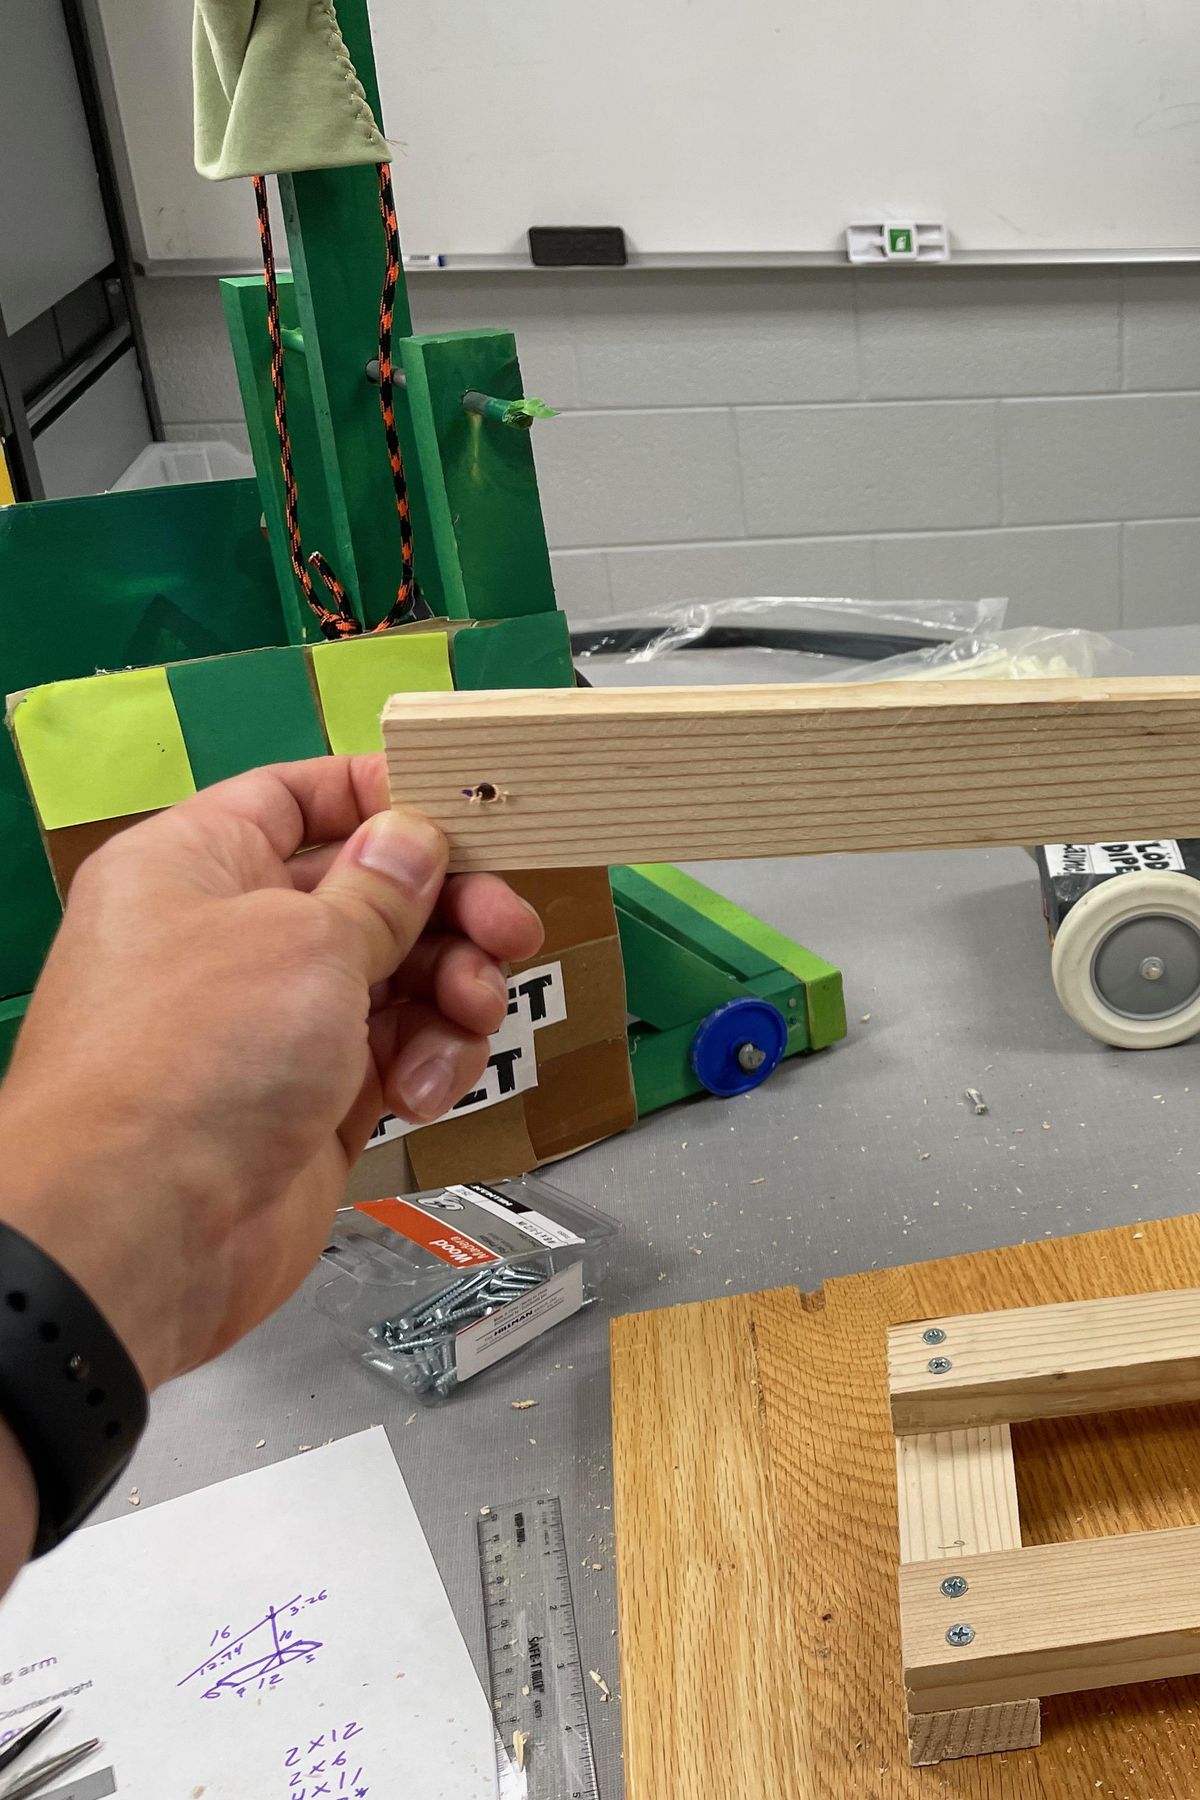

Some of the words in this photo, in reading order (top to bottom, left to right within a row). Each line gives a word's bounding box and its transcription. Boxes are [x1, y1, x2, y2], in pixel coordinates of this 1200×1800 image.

[428, 1238, 473, 1264] Wood
[494, 1310, 533, 1337] HILLMAN
[210, 1625, 231, 1647] 16
[528, 1636, 543, 1668] SAFE-T
[18, 1656, 58, 1677] arm
